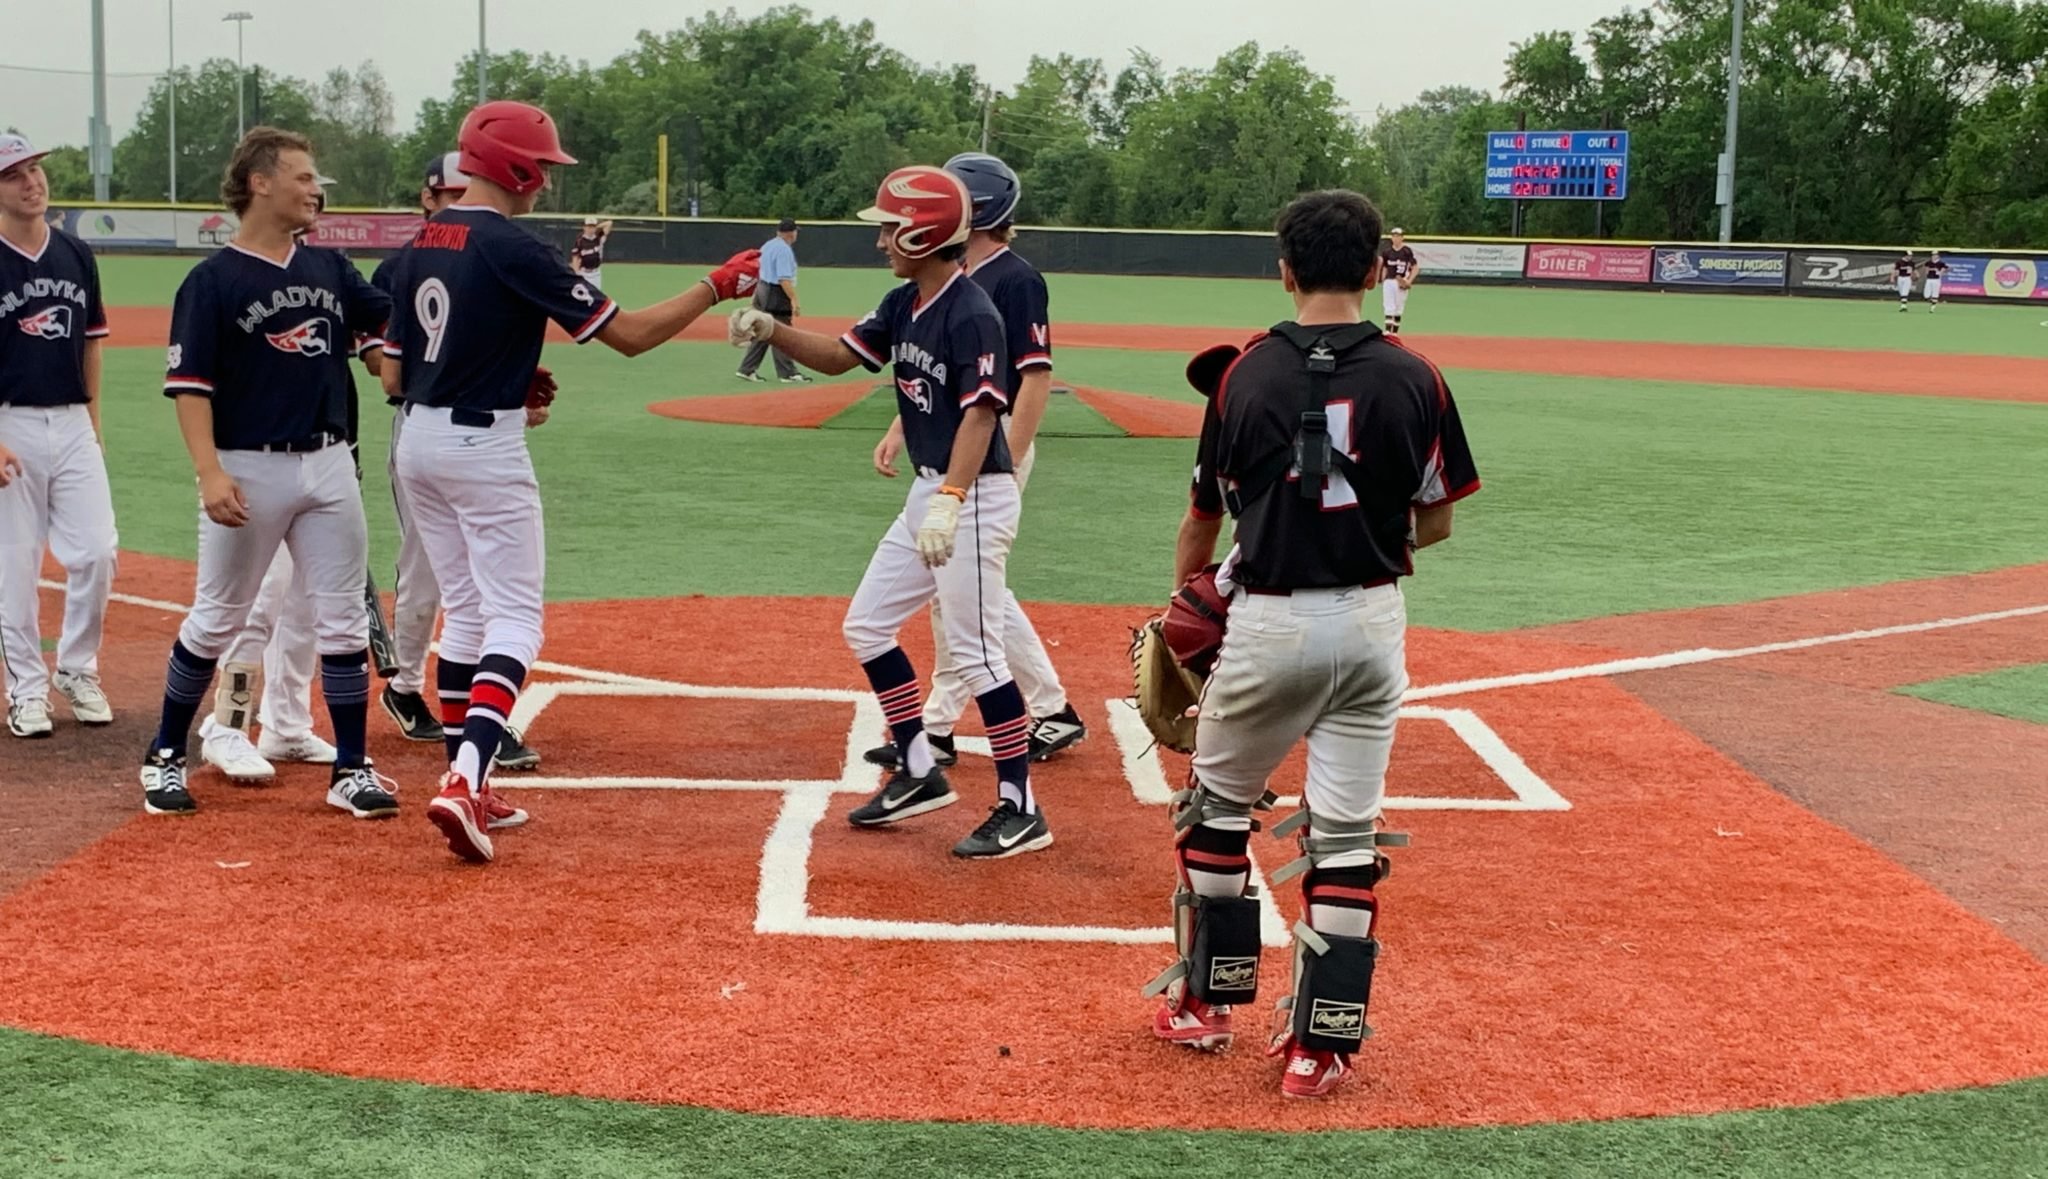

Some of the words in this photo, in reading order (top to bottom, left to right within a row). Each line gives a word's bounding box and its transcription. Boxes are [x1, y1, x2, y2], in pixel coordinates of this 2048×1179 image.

[1494, 138, 1515, 149] BALL
[1531, 138, 1561, 149] STRIKE
[1587, 137, 1609, 148] OUT
[1600, 157, 1623, 167] TOTAL
[1487, 167, 1513, 178] GUEST
[1487, 184, 1511, 195] HOME
[318, 227, 368, 241] DINER
[413, 222, 471, 252] CRONIN
[1538, 257, 1586, 271] DINER
[1699, 258, 1743, 271] SOMERSET
[1743, 259, 1784, 271] PATRIOTS
[571, 283, 594, 307] 9
[236, 285, 344, 334] WLADYKA
[415, 277, 450, 363] 9
[1214, 965, 1254, 983] Rawlings
[1315, 1011, 1361, 1030] Rawlings
[1286, 1056, 1319, 1077] NB
